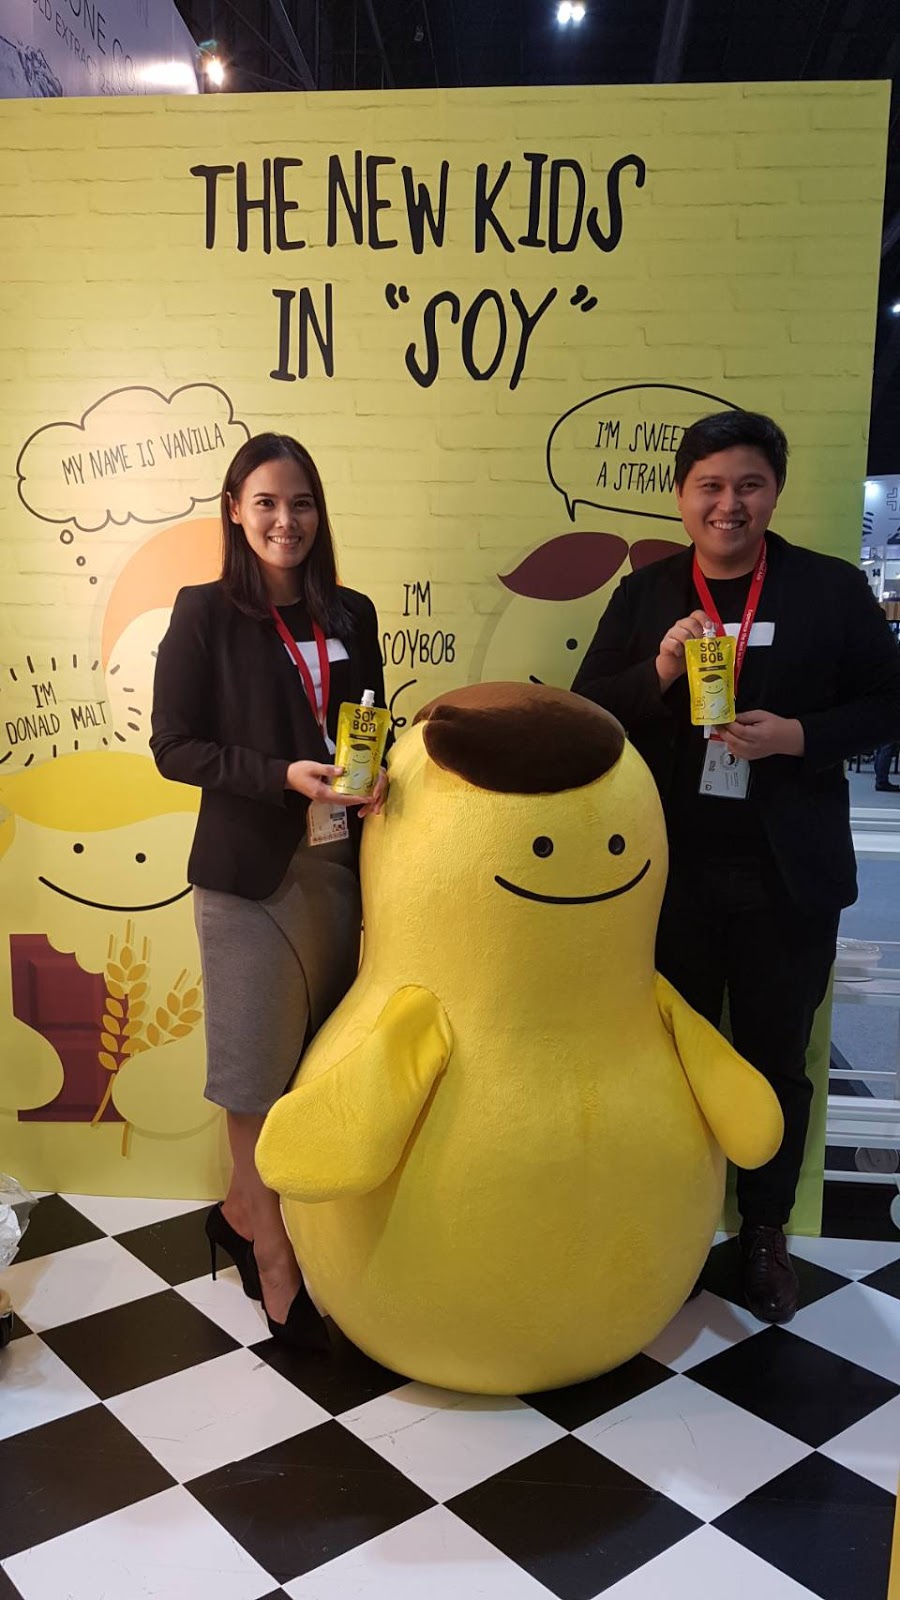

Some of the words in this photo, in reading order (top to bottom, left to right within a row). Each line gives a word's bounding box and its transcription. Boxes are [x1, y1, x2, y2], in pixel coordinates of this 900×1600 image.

[190, 156, 306, 254] THE
[327, 150, 449, 254] NEW
[474, 152, 646, 253] KIDS
[269, 283, 334, 382] IN
[594, 420, 620, 449] I'M
[61, 453, 85, 485] MY
[89, 443, 133, 479] NAME
[136, 439, 156, 468] IS
[160, 422, 225, 460] VANILLA
[596, 461, 607, 488] A
[402, 580, 431, 617] I'M
[382, 628, 456, 669] SOYBOB
[700, 641, 721, 653] SOY
[700, 652, 724, 663] BOB
[31, 681, 57, 709] I'M
[5, 713, 60, 745] DONALD
[70, 700, 107, 730] MALT
[354, 708, 377, 723] SOY
